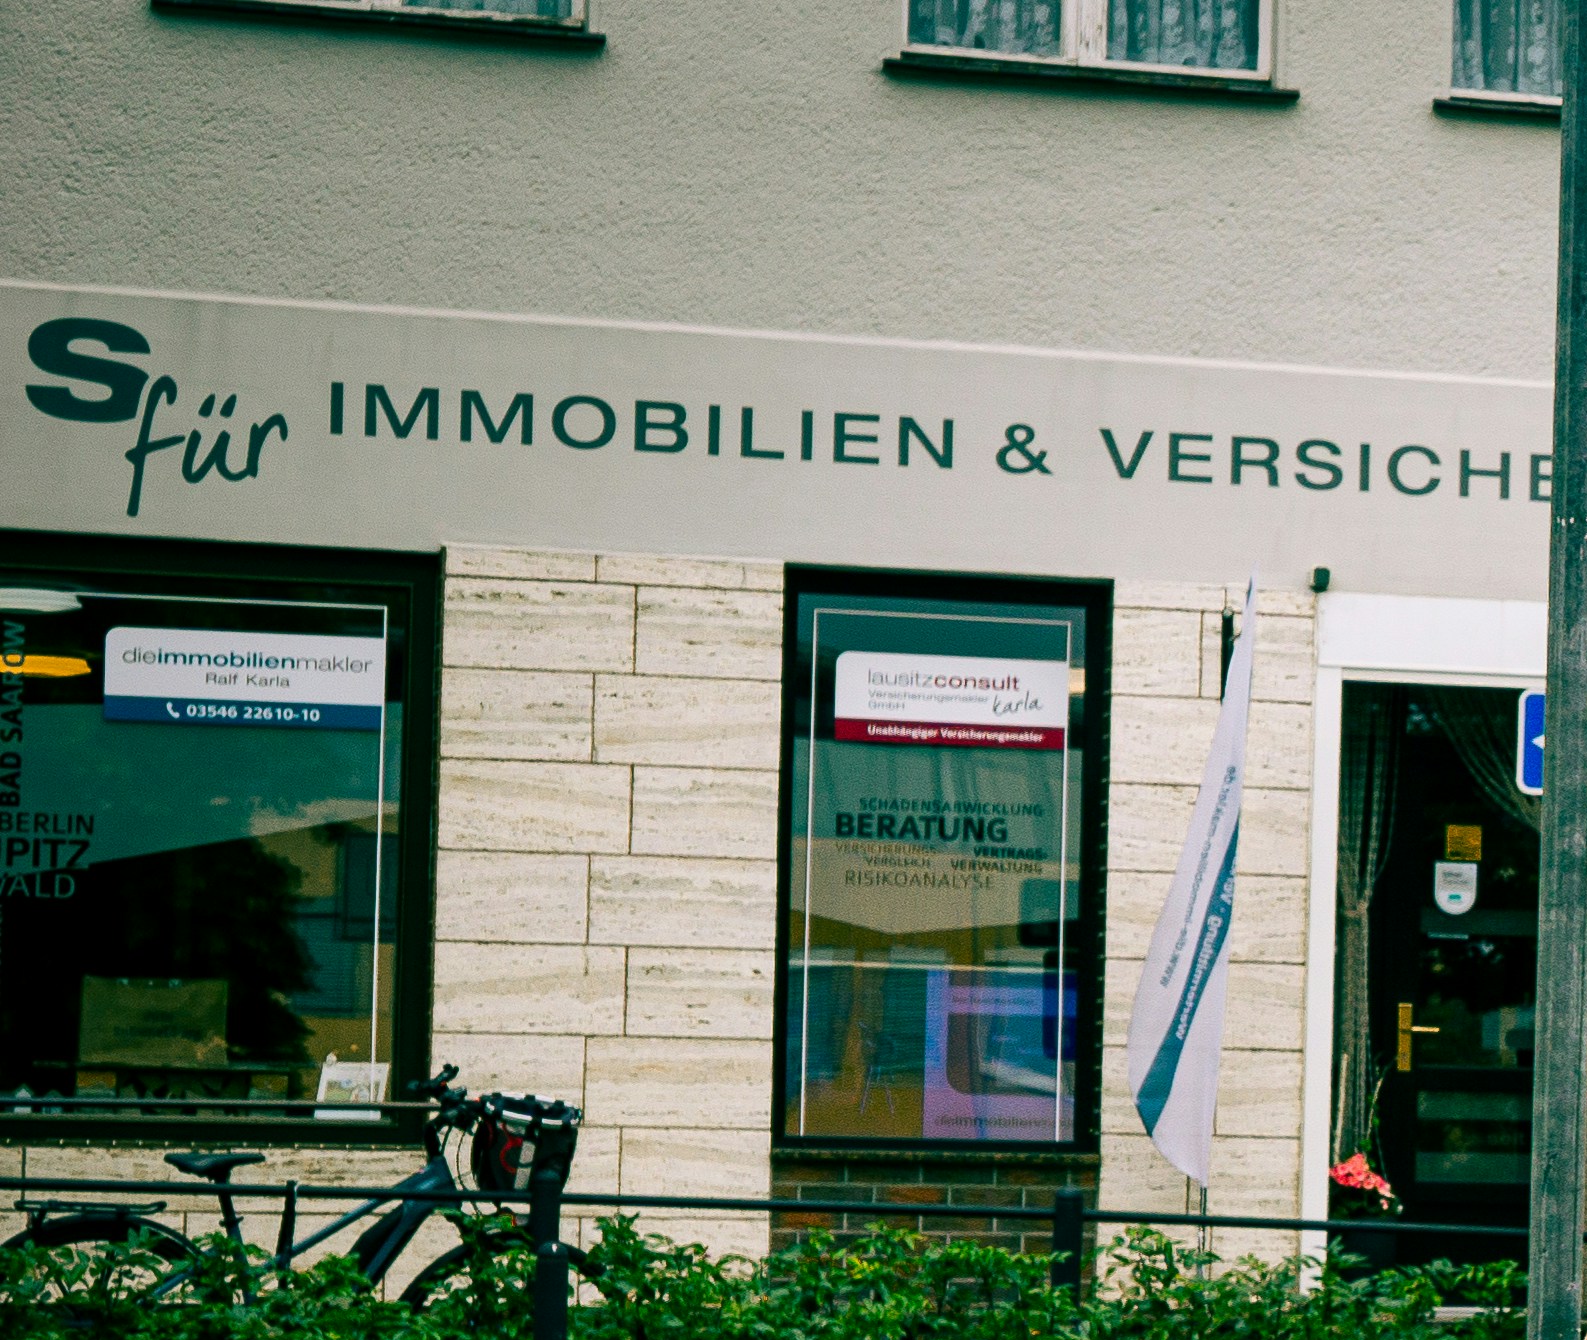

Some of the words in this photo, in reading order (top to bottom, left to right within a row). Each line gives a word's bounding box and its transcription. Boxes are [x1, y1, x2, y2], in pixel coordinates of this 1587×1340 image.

[329, 380, 956, 470] IMMOBILIEN
[995, 423, 1053, 476] &
[125, 374, 289, 518] für
[121, 647, 375, 674] dieimmobilienmakler
[205, 672, 239, 687] Ralf
[246, 674, 291, 689] Karla
[867, 668, 1021, 692] lausitzconsult
[186, 703, 239, 719] 03546
[1, 751, 23, 808] BAD
[834, 810, 1009, 844] BERATUNG
